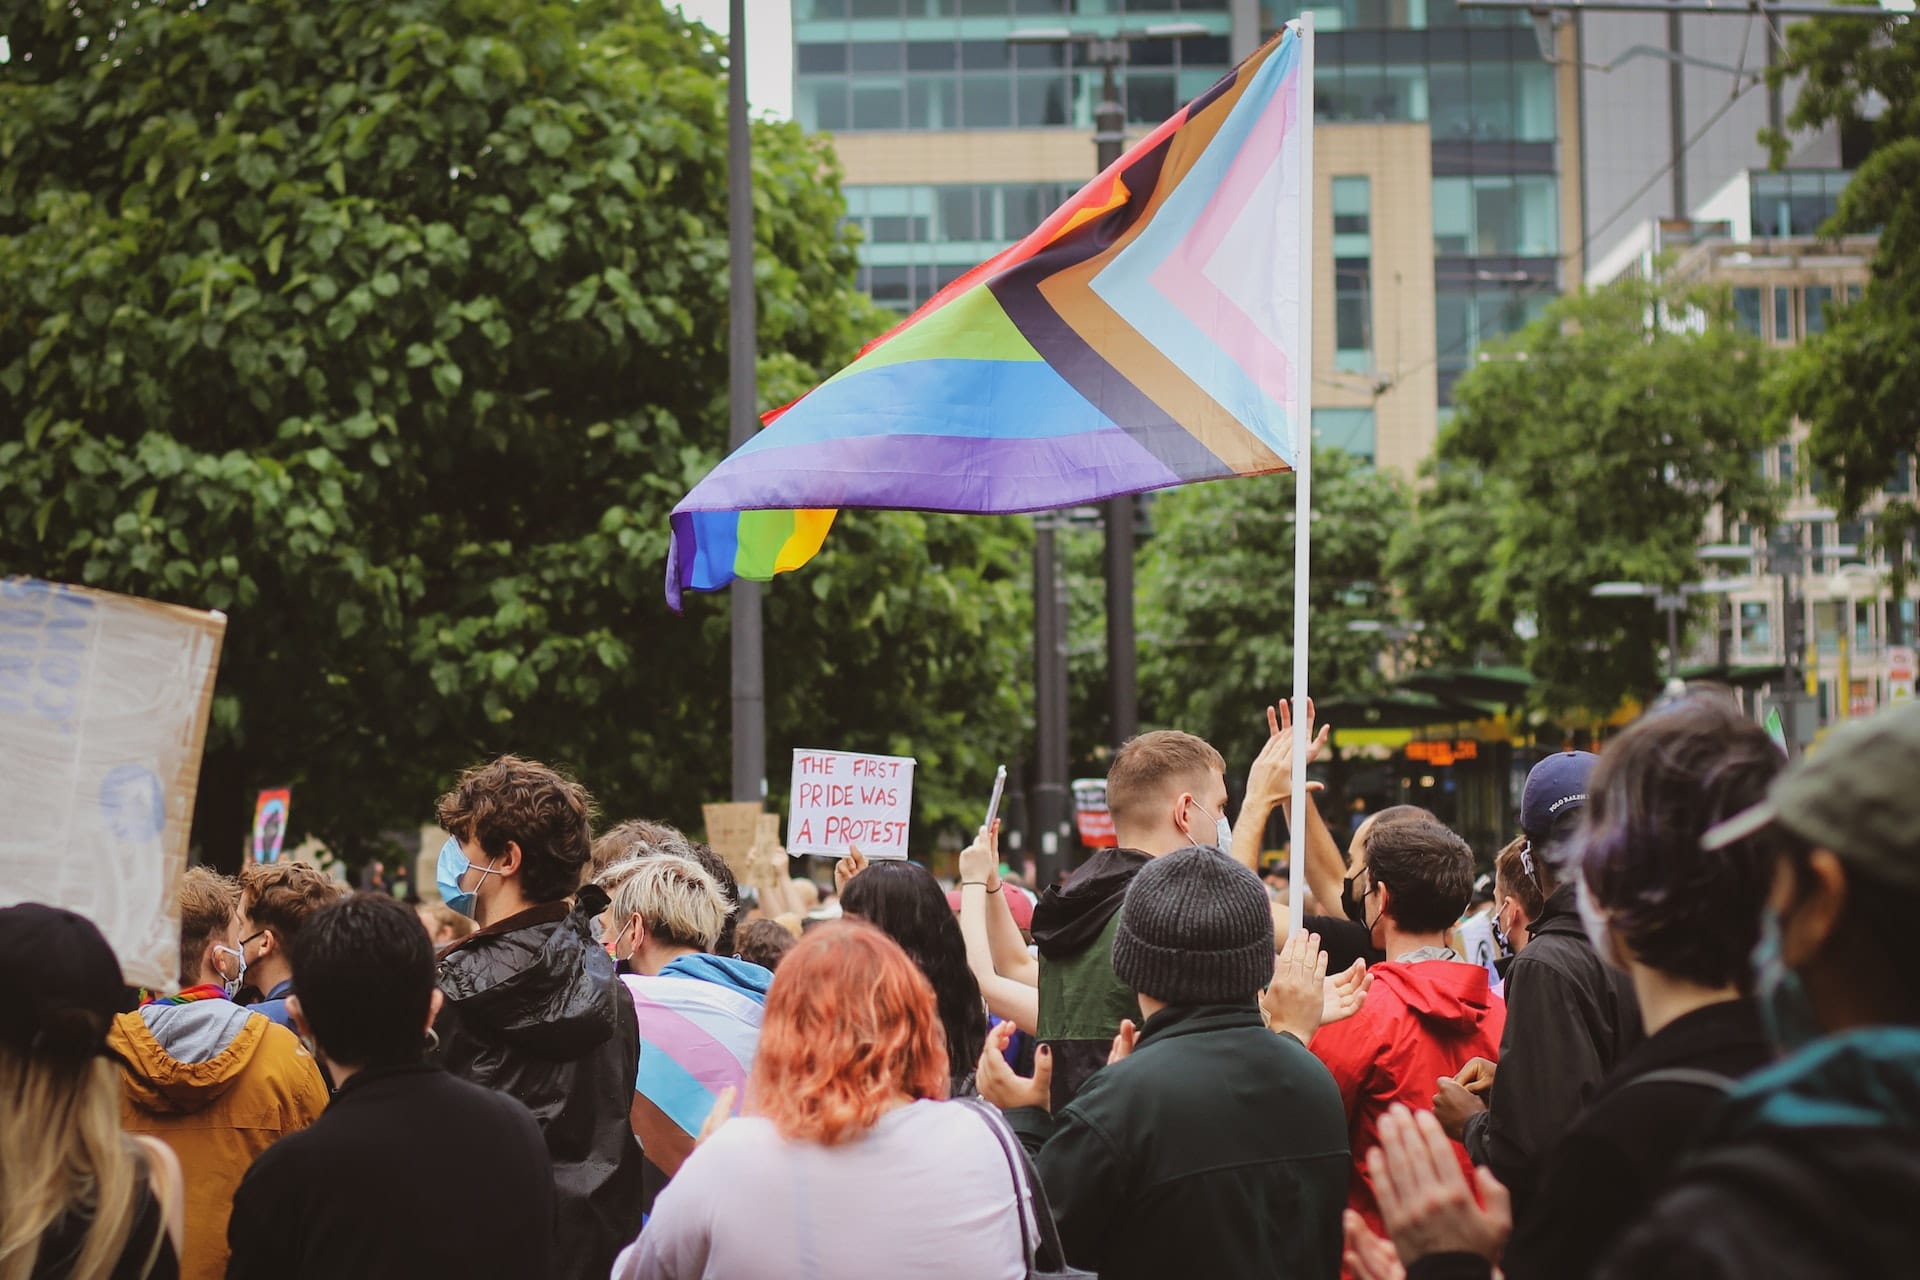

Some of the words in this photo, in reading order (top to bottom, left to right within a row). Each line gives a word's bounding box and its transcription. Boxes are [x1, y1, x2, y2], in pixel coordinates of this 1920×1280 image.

[799, 756, 836, 775] THE
[853, 759, 900, 778] FIRST
[800, 782, 854, 808] PRIDE
[860, 786, 897, 806] WAS
[1549, 799, 1563, 812] POLO
[796, 818, 812, 844] A
[824, 815, 907, 846] PROTEST
